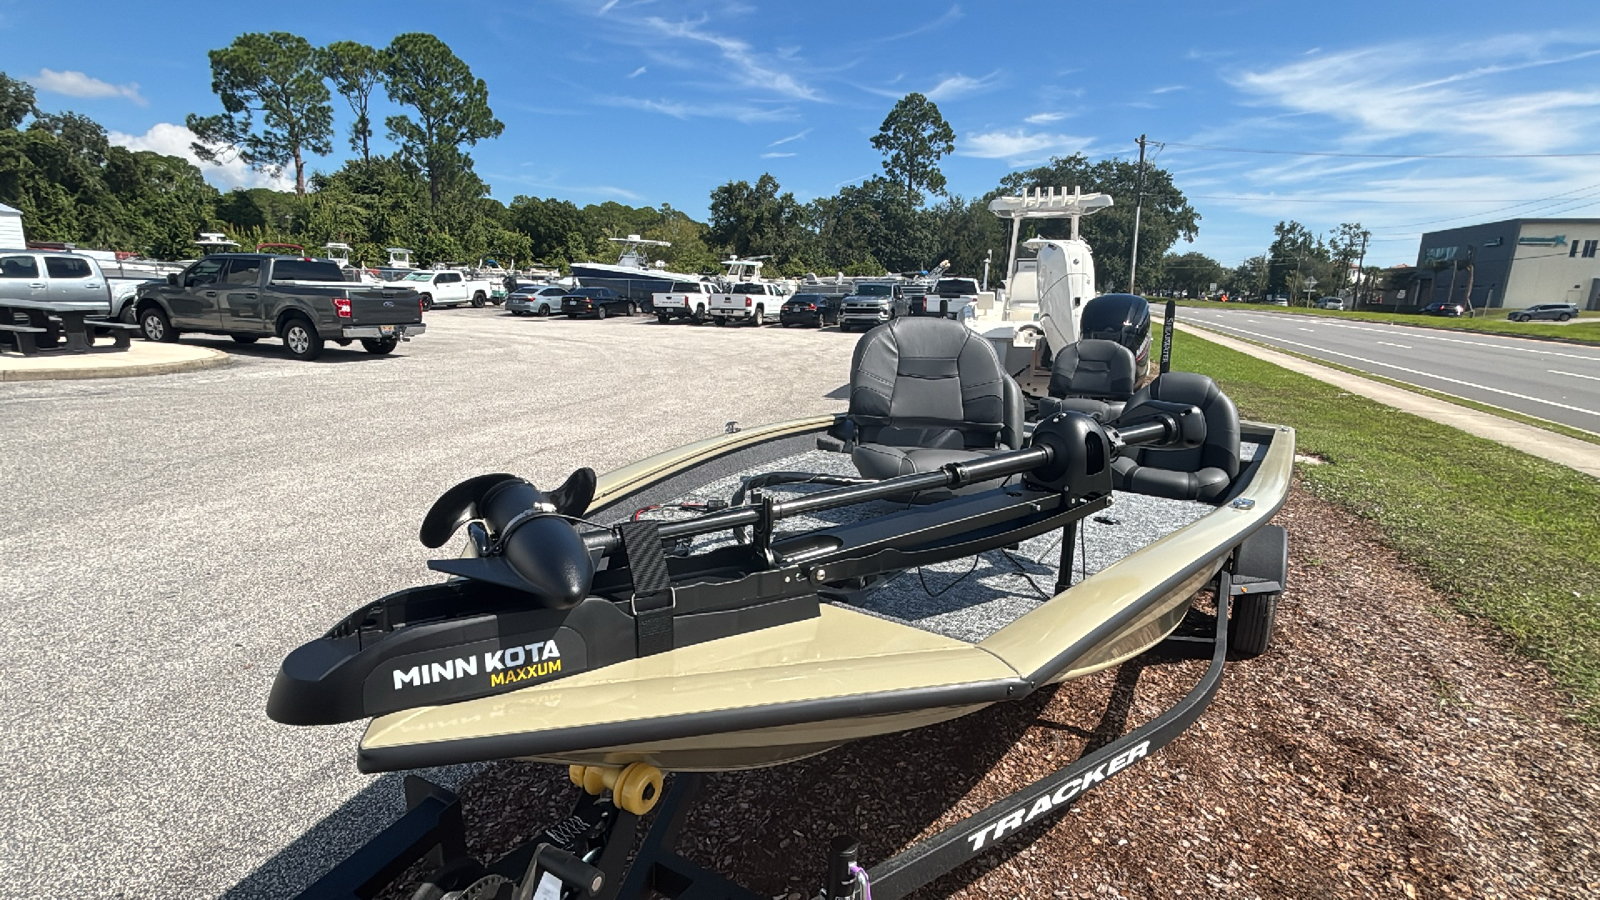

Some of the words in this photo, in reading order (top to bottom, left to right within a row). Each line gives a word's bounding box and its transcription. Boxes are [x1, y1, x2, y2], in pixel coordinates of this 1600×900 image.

[1162, 317, 1174, 363] SHEARWATER
[393, 655, 478, 690] MINN
[485, 639, 561, 673] KOTA
[490, 659, 562, 687] MAXXUM
[967, 740, 1151, 851] TRACKER
